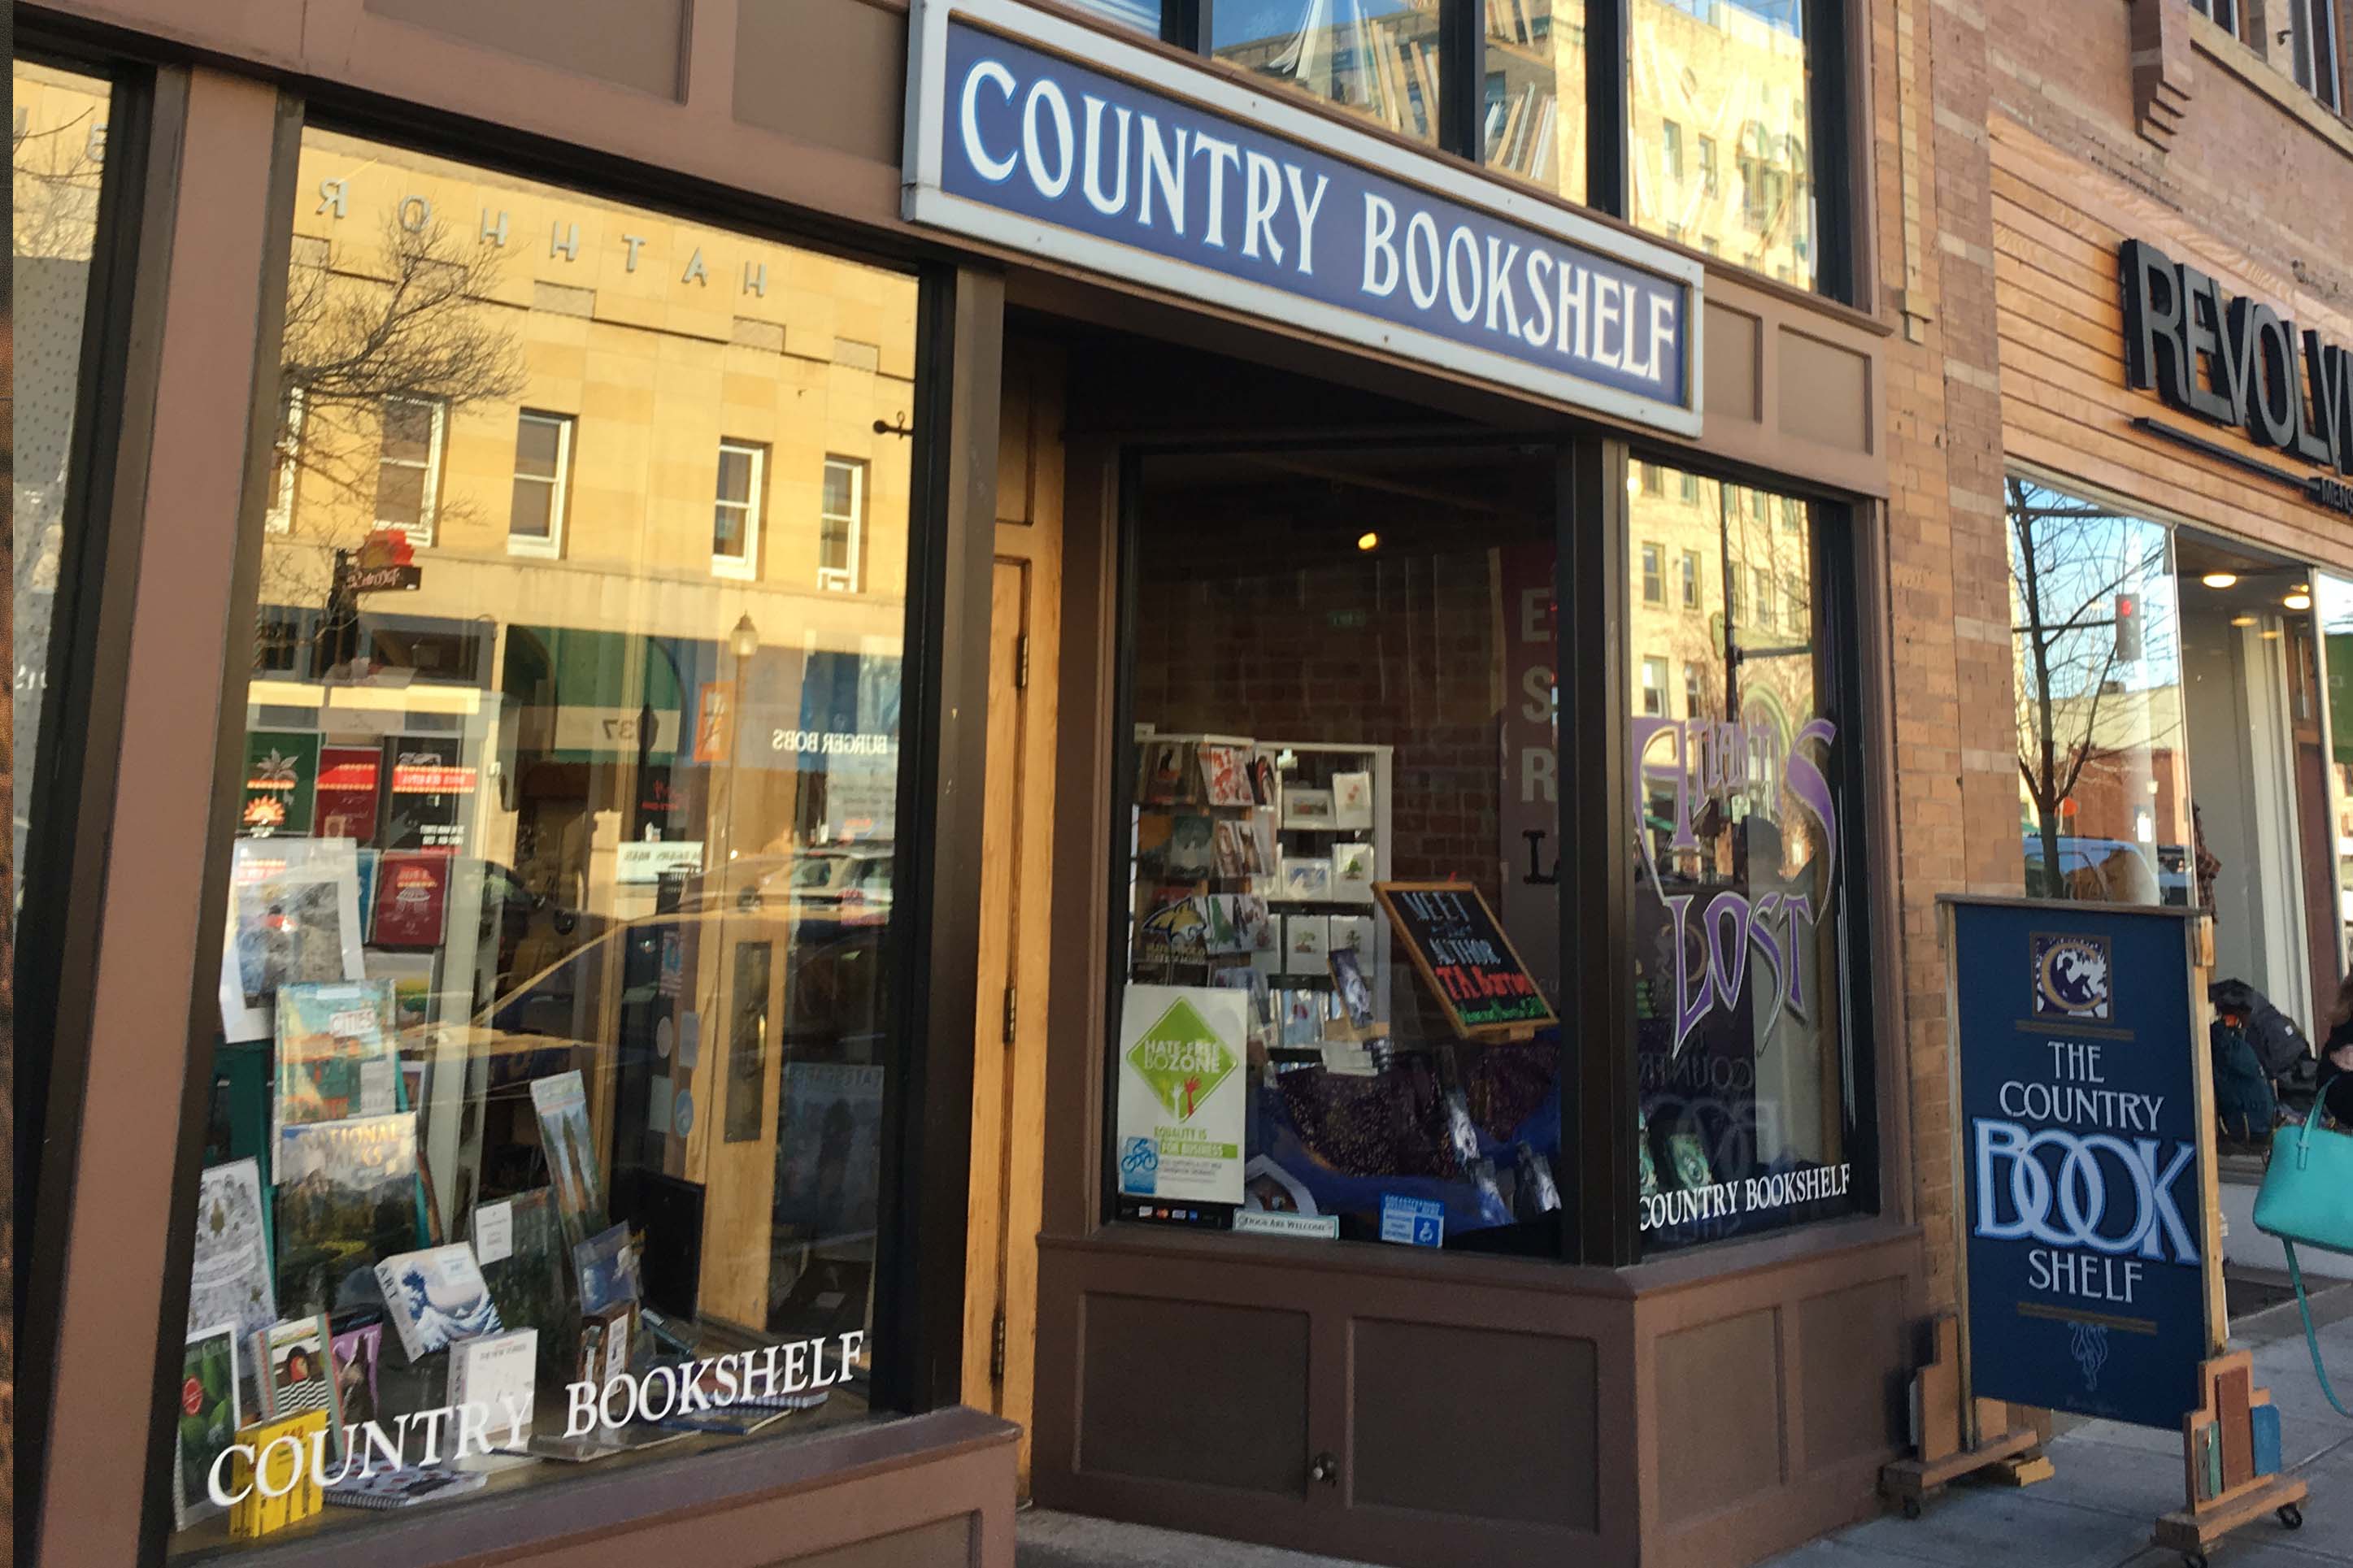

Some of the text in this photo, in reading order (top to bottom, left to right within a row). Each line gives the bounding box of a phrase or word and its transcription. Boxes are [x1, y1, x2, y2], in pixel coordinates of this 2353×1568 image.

[960, 60, 1675, 383] COUNTRY BOOKSHELF
[2120, 238, 2353, 480] REVOLV
[1664, 892, 1812, 1059] LOST
[1999, 1081, 2165, 1133] COUNTRY
[2047, 1040, 2106, 1084] THE
[1640, 1179, 1738, 1231] COUNTRY
[1746, 1163, 1851, 1213] BOOKSHELF
[1972, 1117, 2203, 1266] BOOK
[376, 1266, 398, 1301] ART
[2028, 1248, 2143, 1304] SHELF
[207, 1389, 535, 1509] COUNTRY
[562, 1330, 865, 1440] BOOKSHELF
